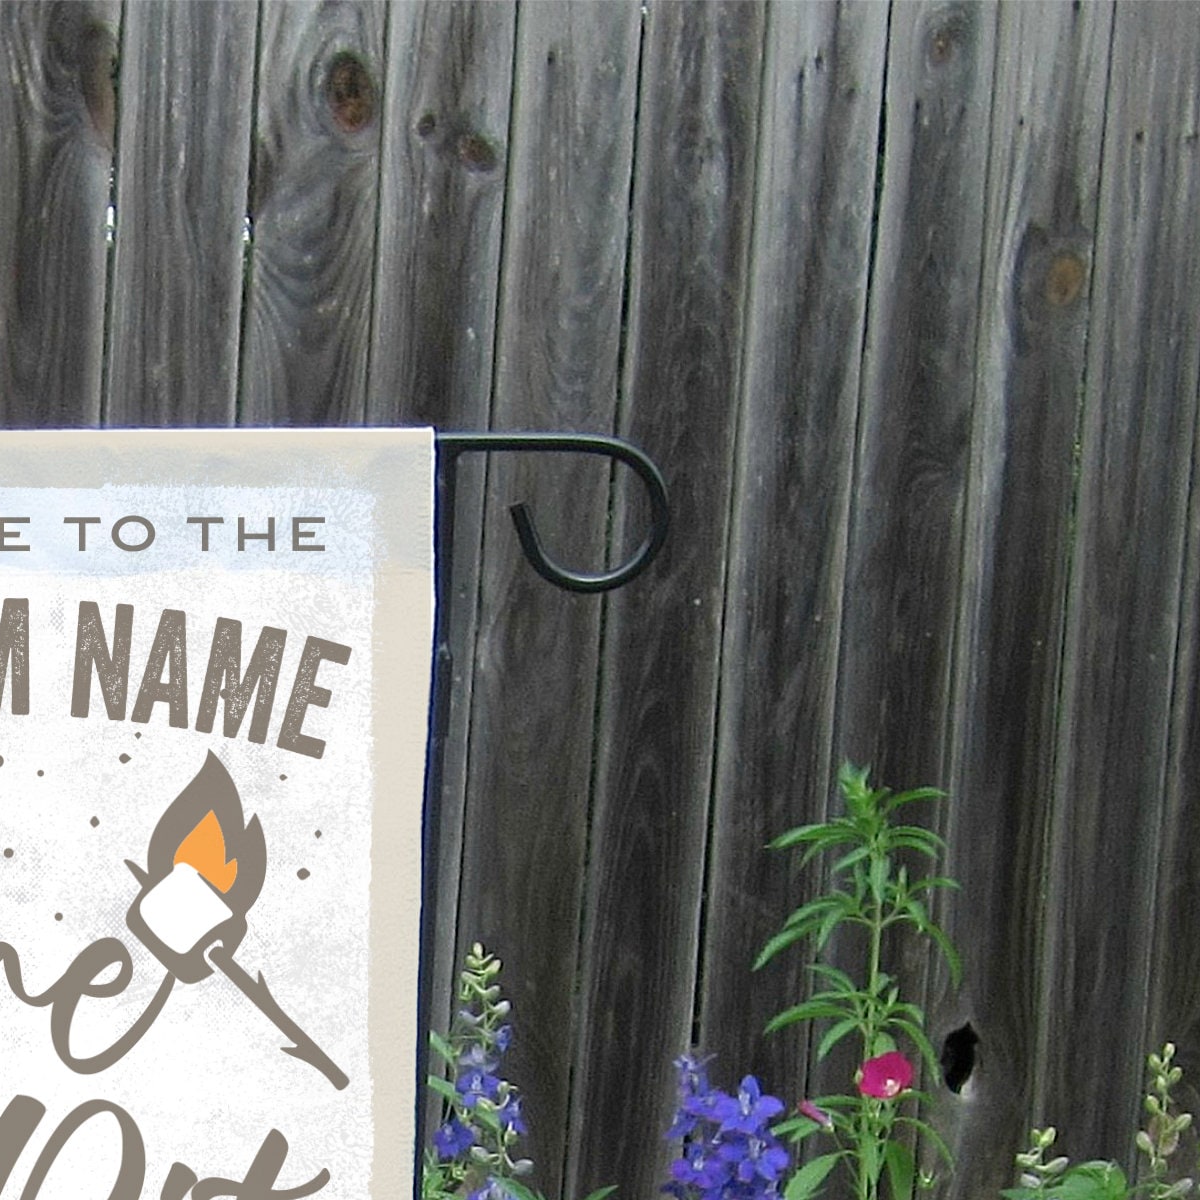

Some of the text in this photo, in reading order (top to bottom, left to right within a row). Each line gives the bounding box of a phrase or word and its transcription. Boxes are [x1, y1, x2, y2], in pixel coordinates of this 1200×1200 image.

[64, 516, 156, 552] TO
[187, 516, 326, 552] THE
[70, 600, 353, 760] NAME
